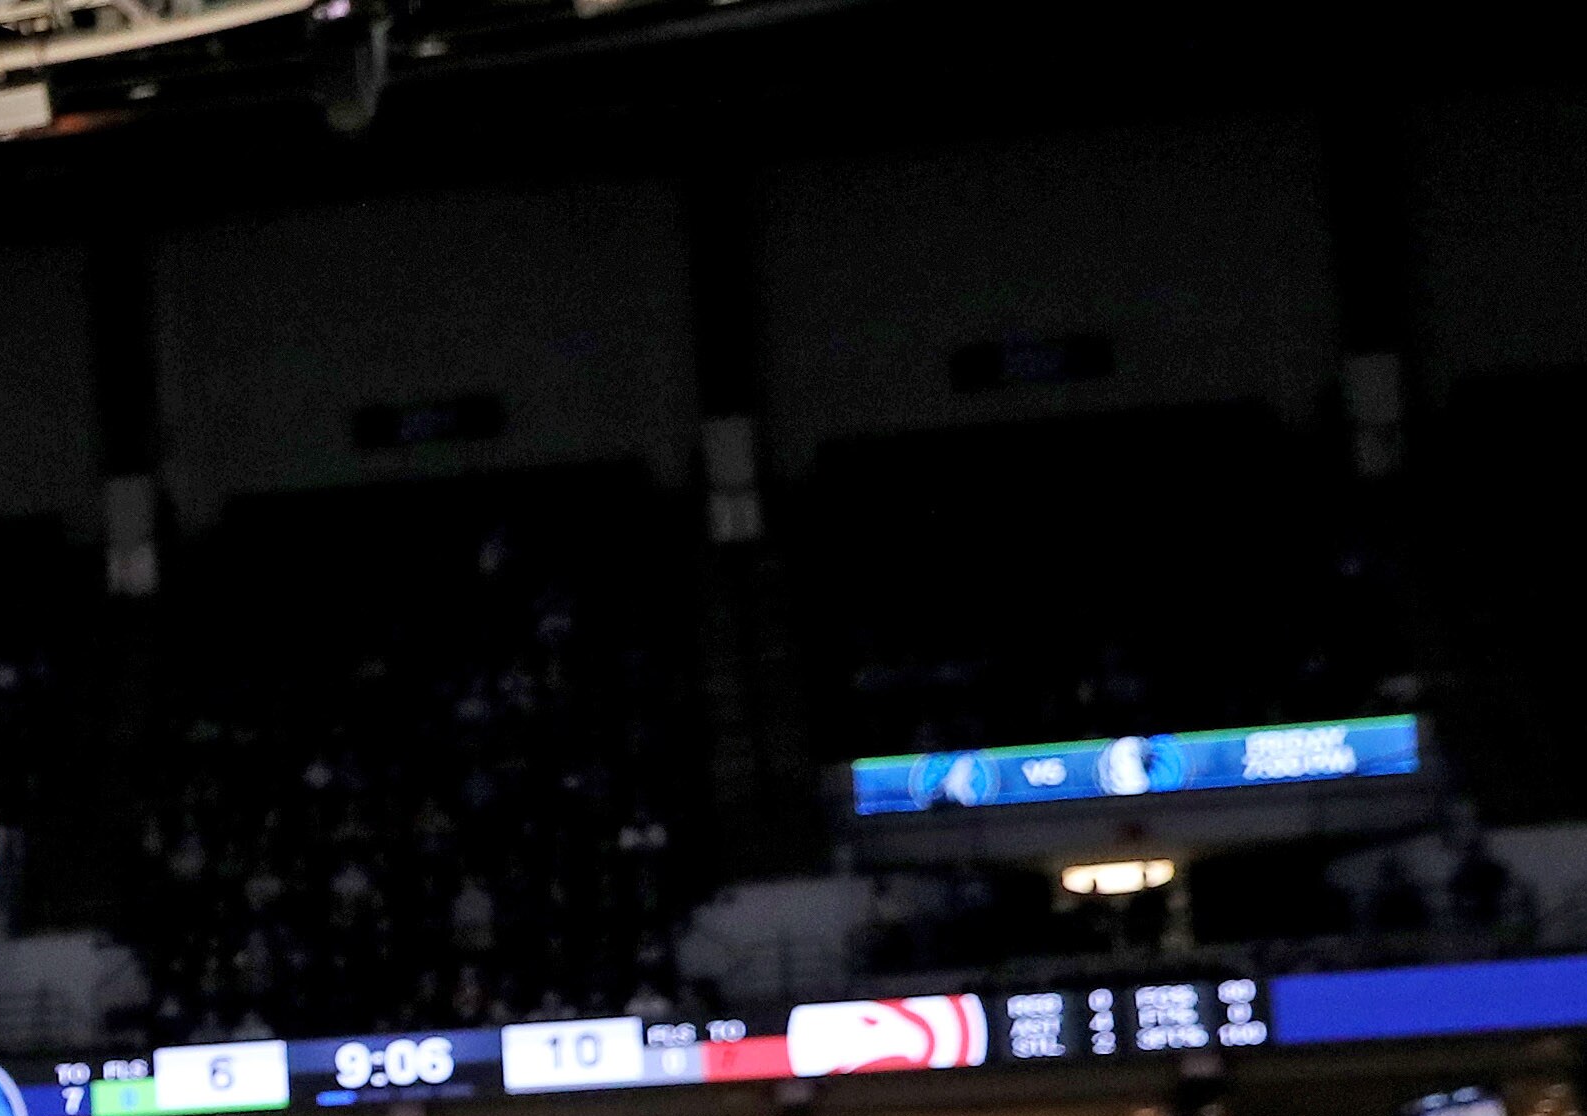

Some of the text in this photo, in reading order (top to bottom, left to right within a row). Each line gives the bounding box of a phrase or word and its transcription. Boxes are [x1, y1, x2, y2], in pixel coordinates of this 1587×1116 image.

[334, 1036, 455, 1089] 9:06
[547, 1033, 603, 1070] 10
[208, 1054, 234, 1092] 6
[61, 1086, 85, 1115] 7
